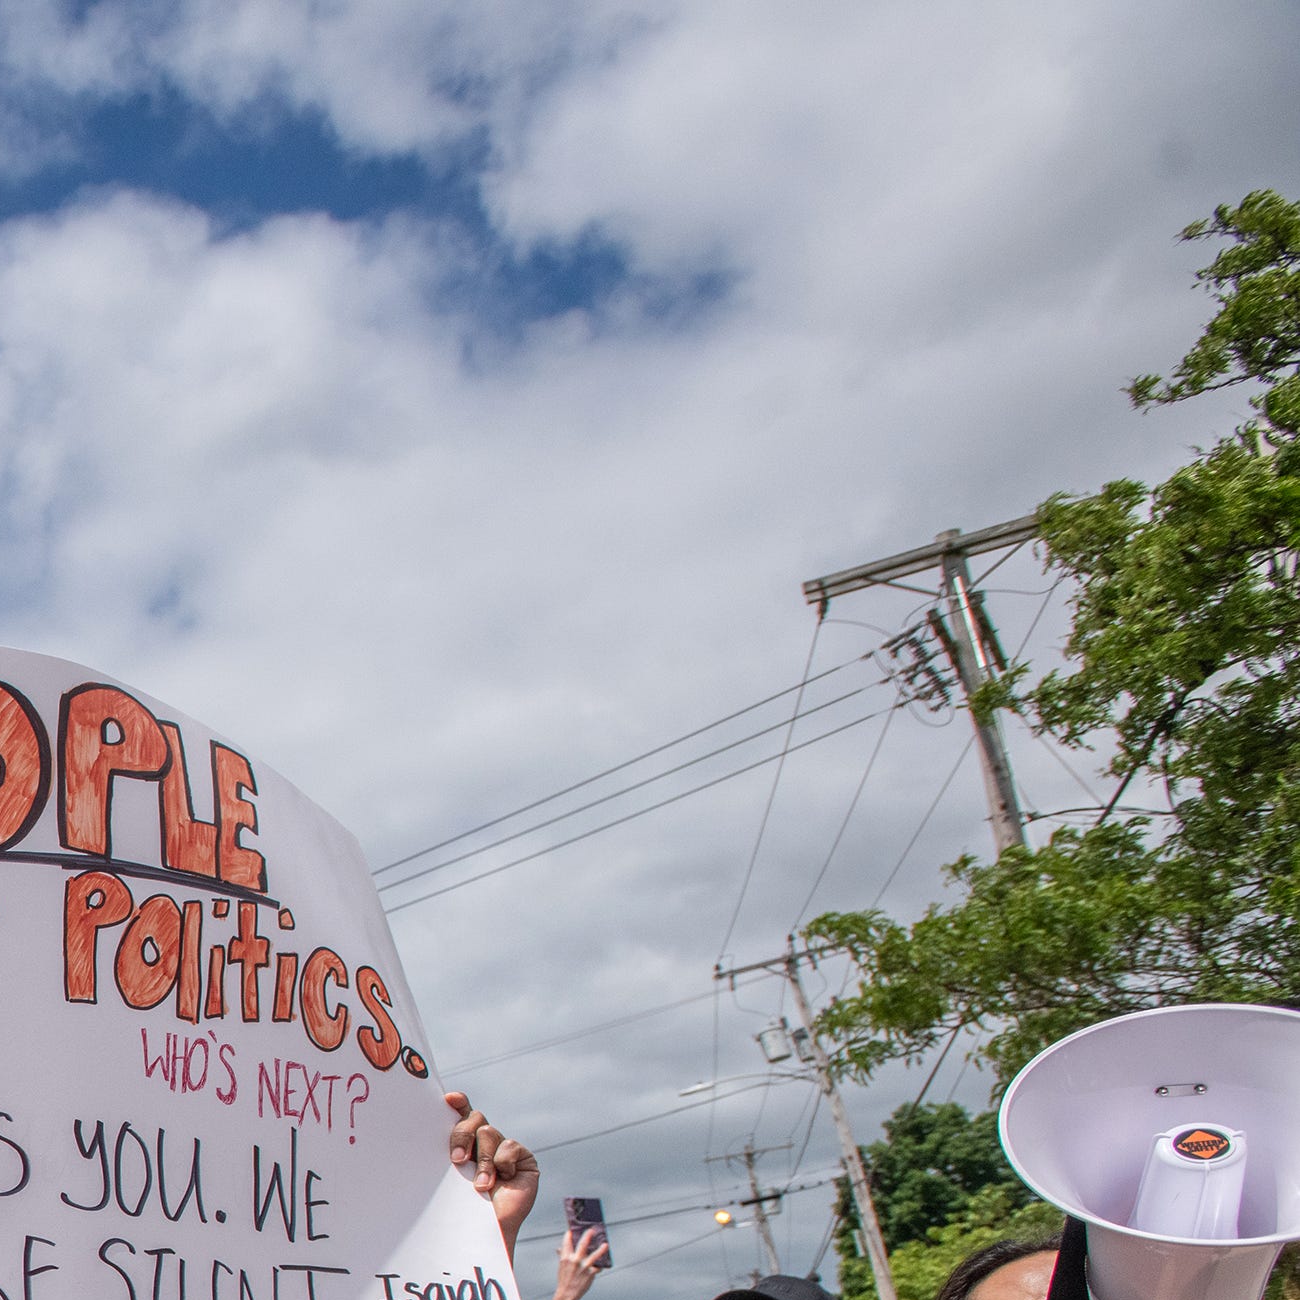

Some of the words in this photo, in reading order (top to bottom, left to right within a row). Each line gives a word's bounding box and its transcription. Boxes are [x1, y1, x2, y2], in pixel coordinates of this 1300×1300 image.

[139, 1026, 239, 1106] WHO'S
[256, 1058, 371, 1145] NEXT?
[1181, 1139, 1224, 1148] WESTERN
[60, 1118, 228, 1225] YOU.
[252, 1128, 331, 1242] WE
